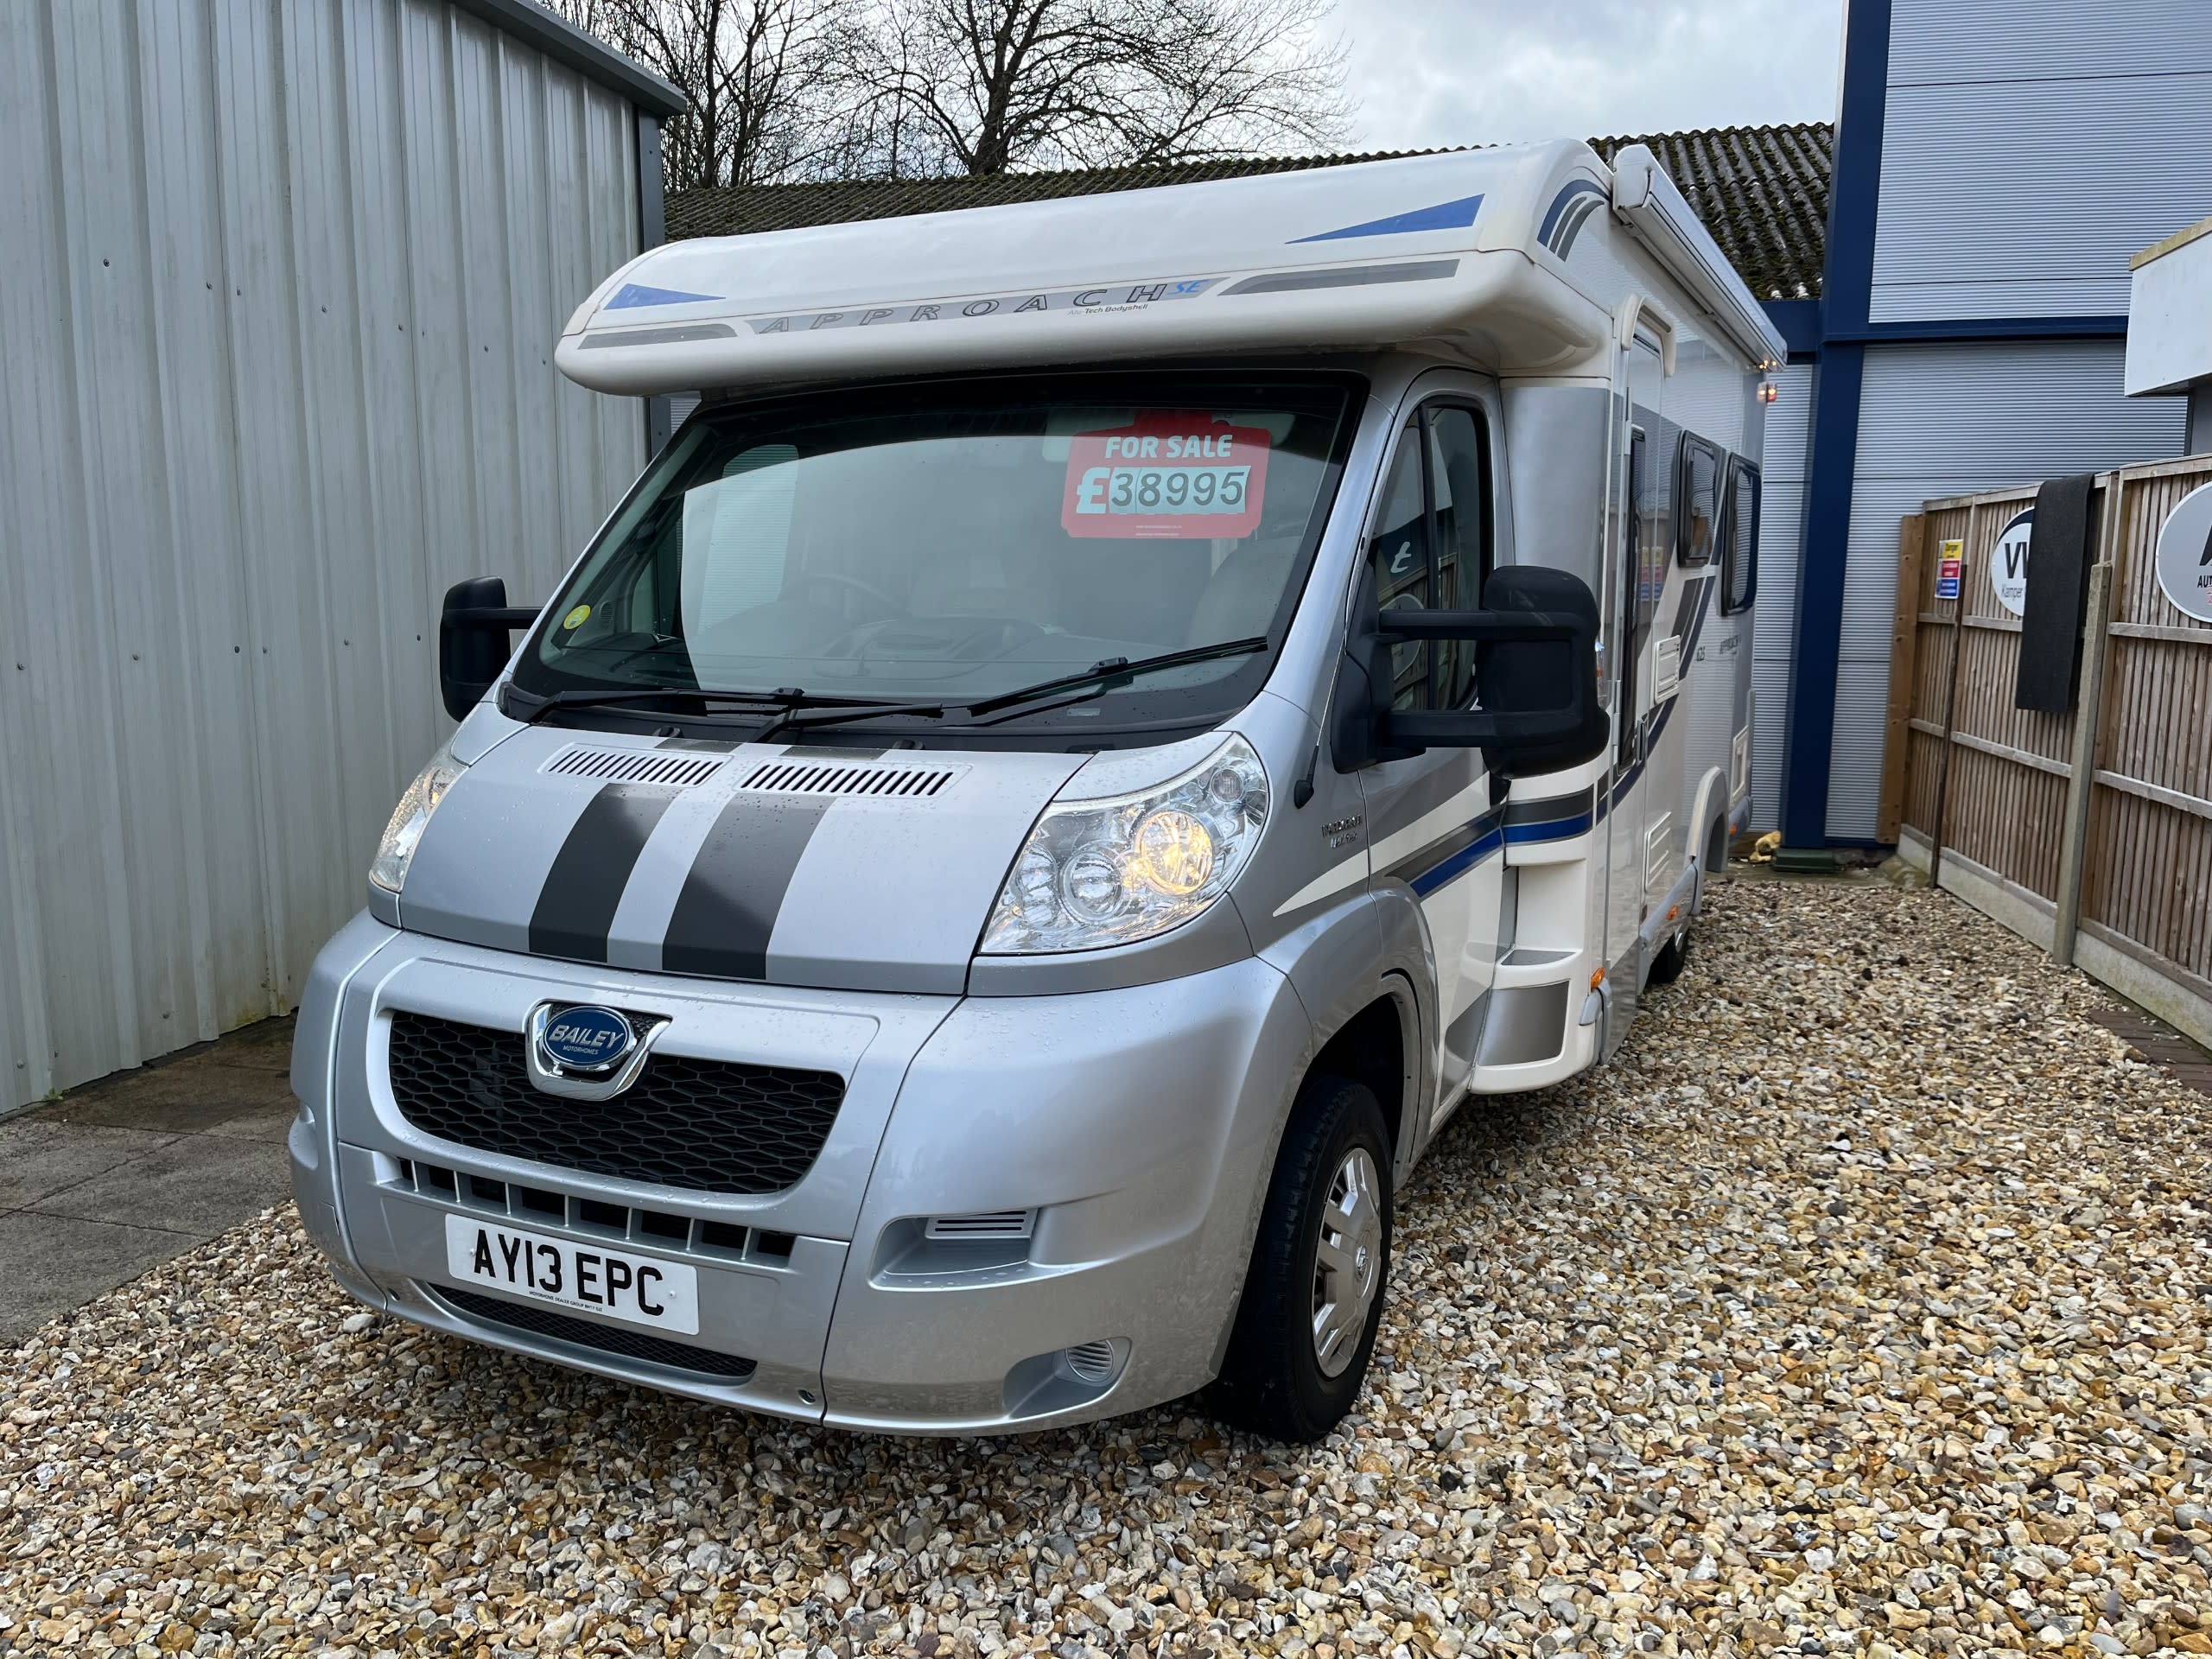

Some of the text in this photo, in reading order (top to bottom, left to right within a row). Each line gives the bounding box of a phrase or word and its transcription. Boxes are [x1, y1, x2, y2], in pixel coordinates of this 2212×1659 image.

[759, 280, 1205, 334] APPROACH SE
[1104, 303, 1148, 313] Bodyshell
[1105, 435, 1233, 459] FOR SALE
[1076, 467, 1245, 514] £38995
[548, 1024, 624, 1049] BAILEY
[563, 1045, 599, 1055] MOTORHOMES
[474, 1229, 664, 1317] AY13 EPC
